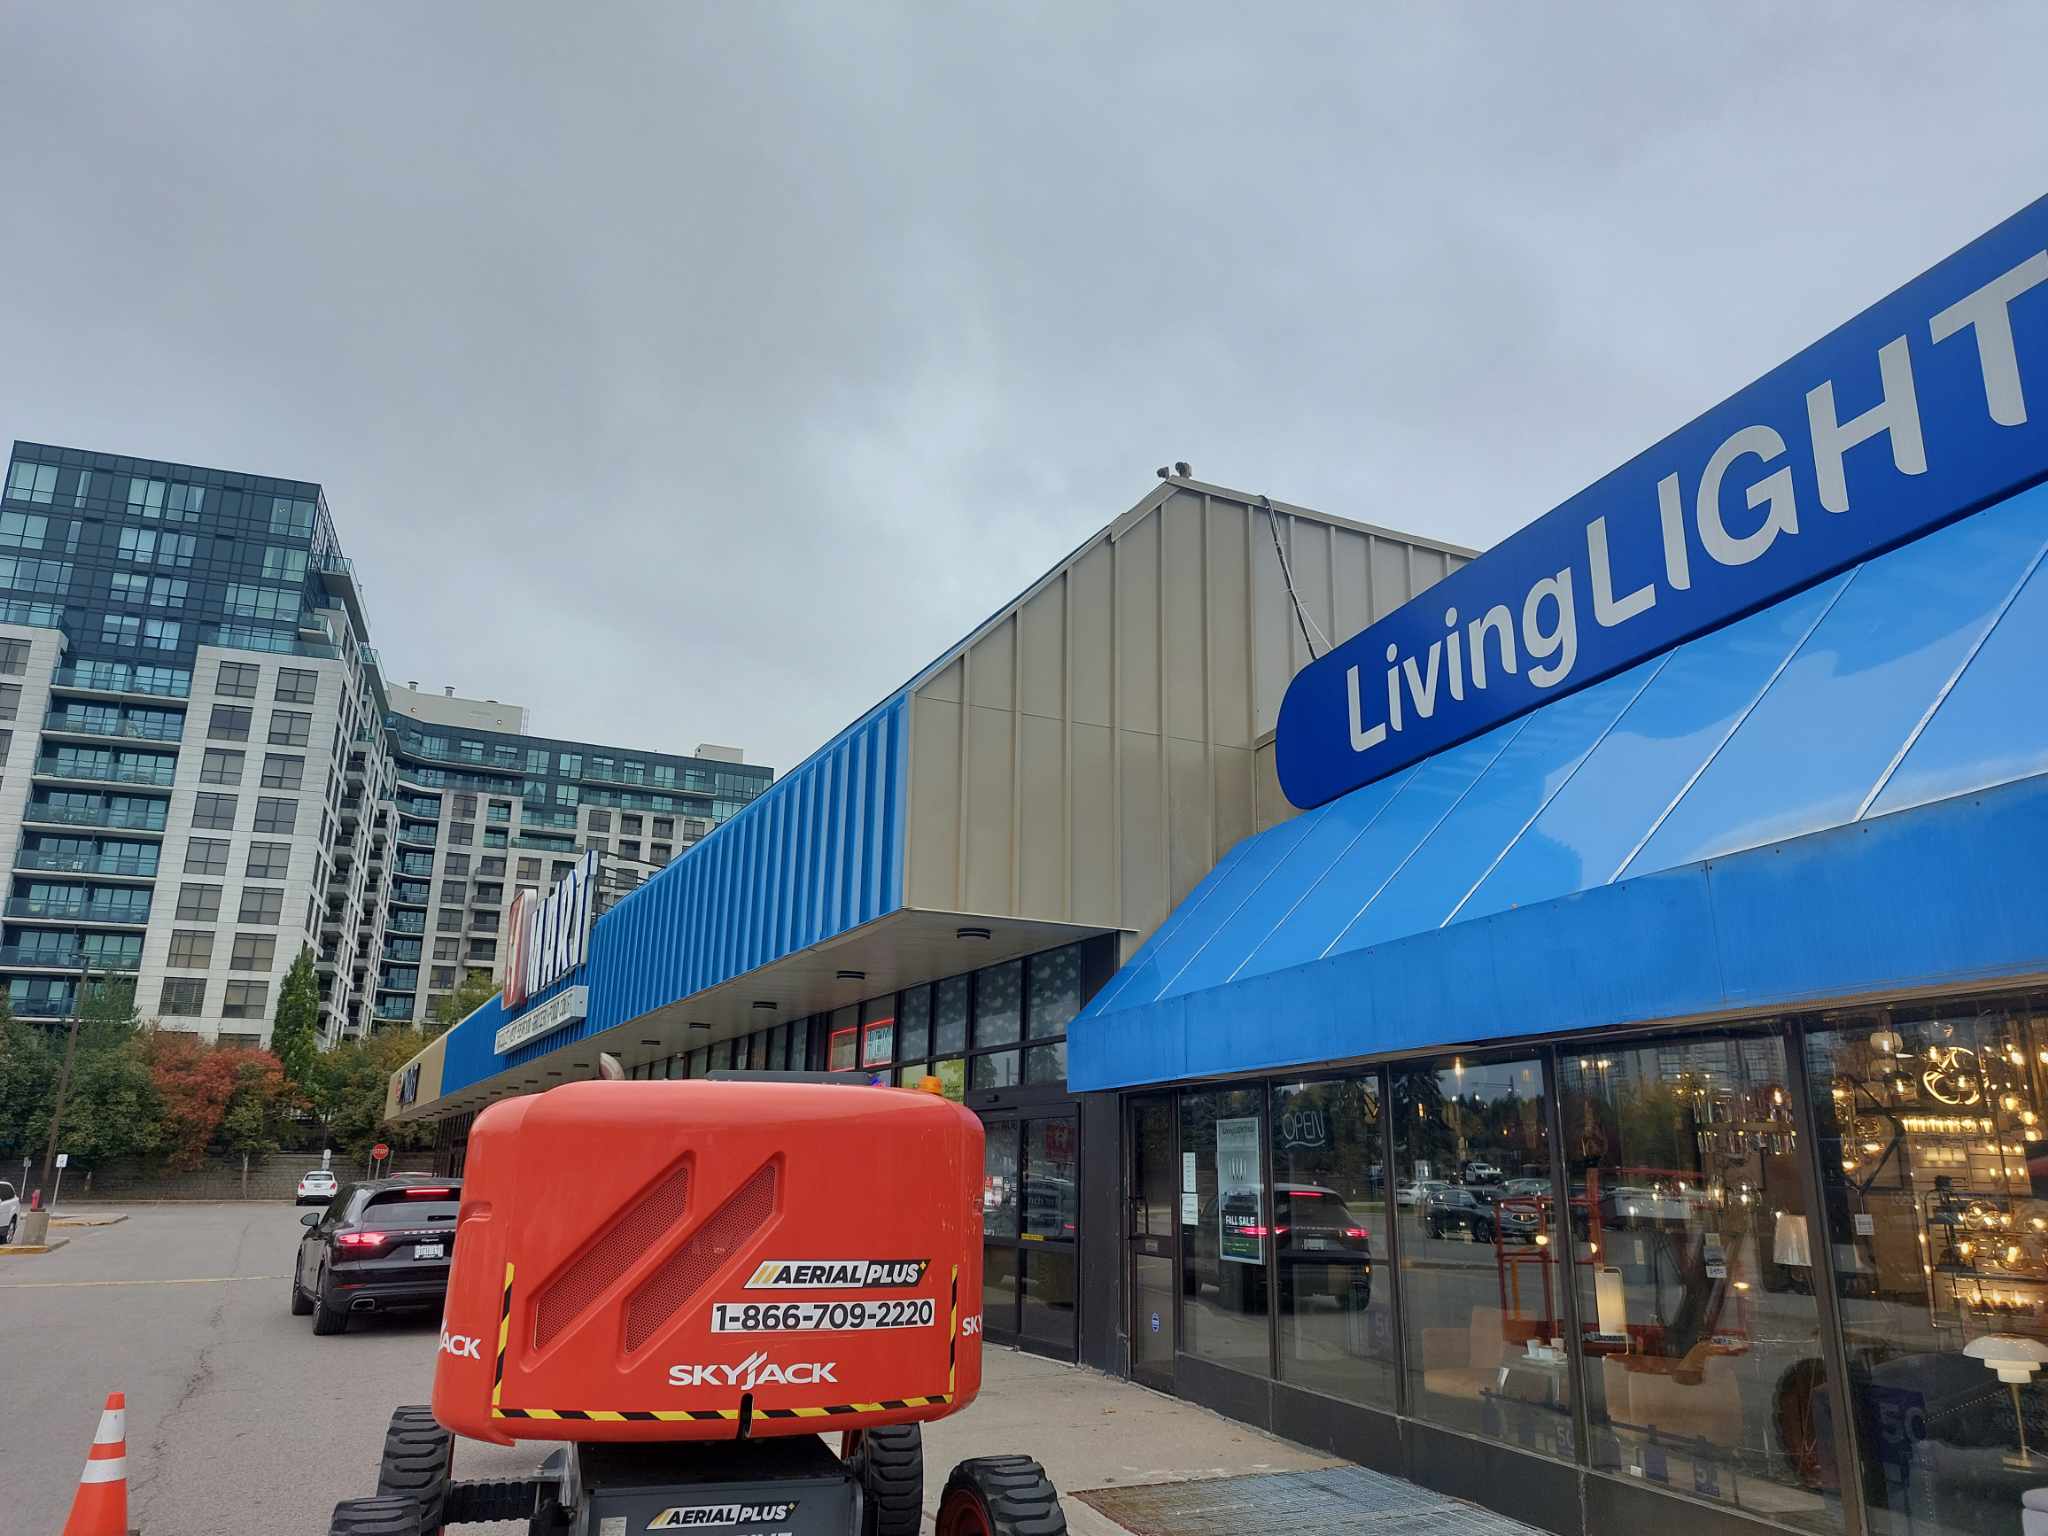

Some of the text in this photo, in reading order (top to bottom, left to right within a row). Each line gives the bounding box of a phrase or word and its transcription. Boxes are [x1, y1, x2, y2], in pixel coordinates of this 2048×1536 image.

[526, 850, 598, 998] MART
[1282, 1110, 1325, 1140] OPEN
[1225, 1215, 1255, 1226] FALL SALE
[772, 1262, 919, 1284] AERIAL PLUS
[715, 1300, 932, 1331] 1-866-709-2220
[668, 1351, 839, 1390] SKYJACK
[666, 1504, 788, 1526] AERIAL PLUS
